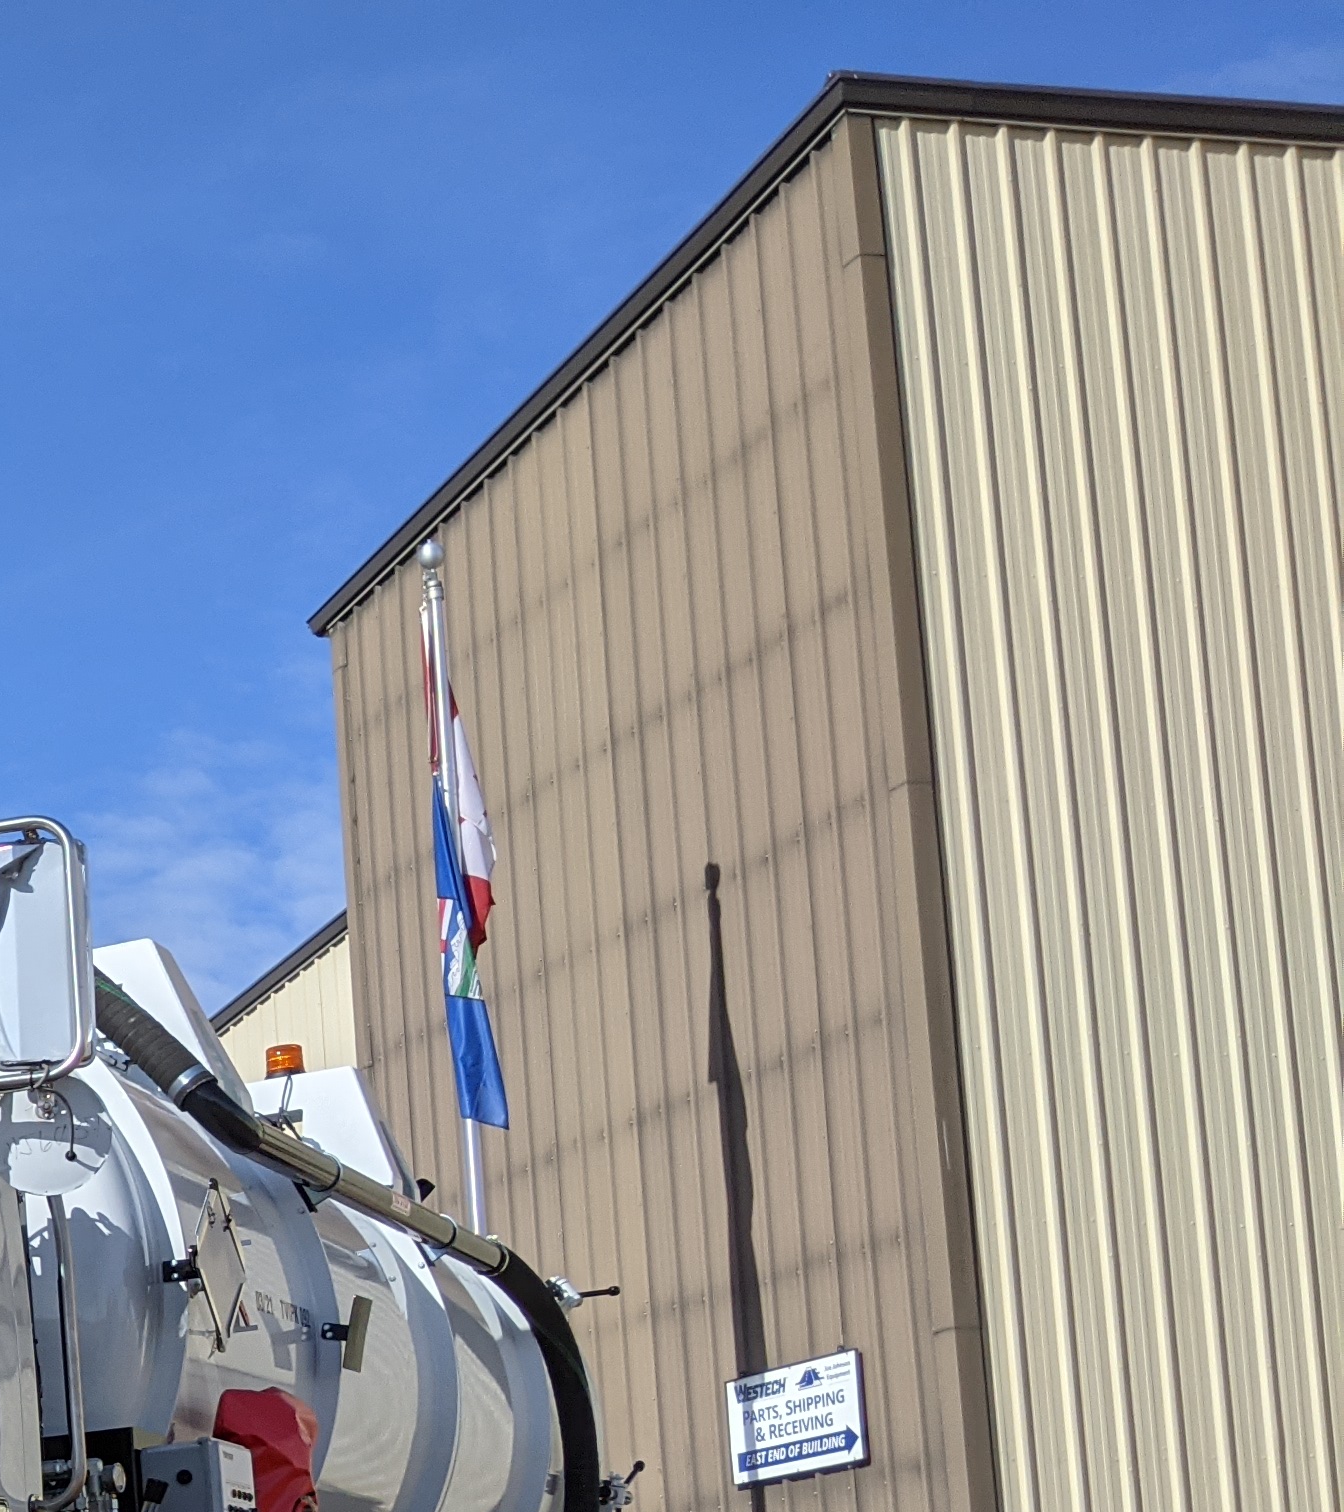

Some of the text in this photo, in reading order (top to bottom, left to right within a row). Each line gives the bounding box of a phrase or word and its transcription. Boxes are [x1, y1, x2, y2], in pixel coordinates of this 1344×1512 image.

[734, 1377, 787, 1404] WESTECH
[743, 1389, 845, 1425] PARTS, SHIPPING
[755, 1412, 834, 1442] & RECEIVING
[746, 1434, 846, 1467] EAST END OF BUILDING
